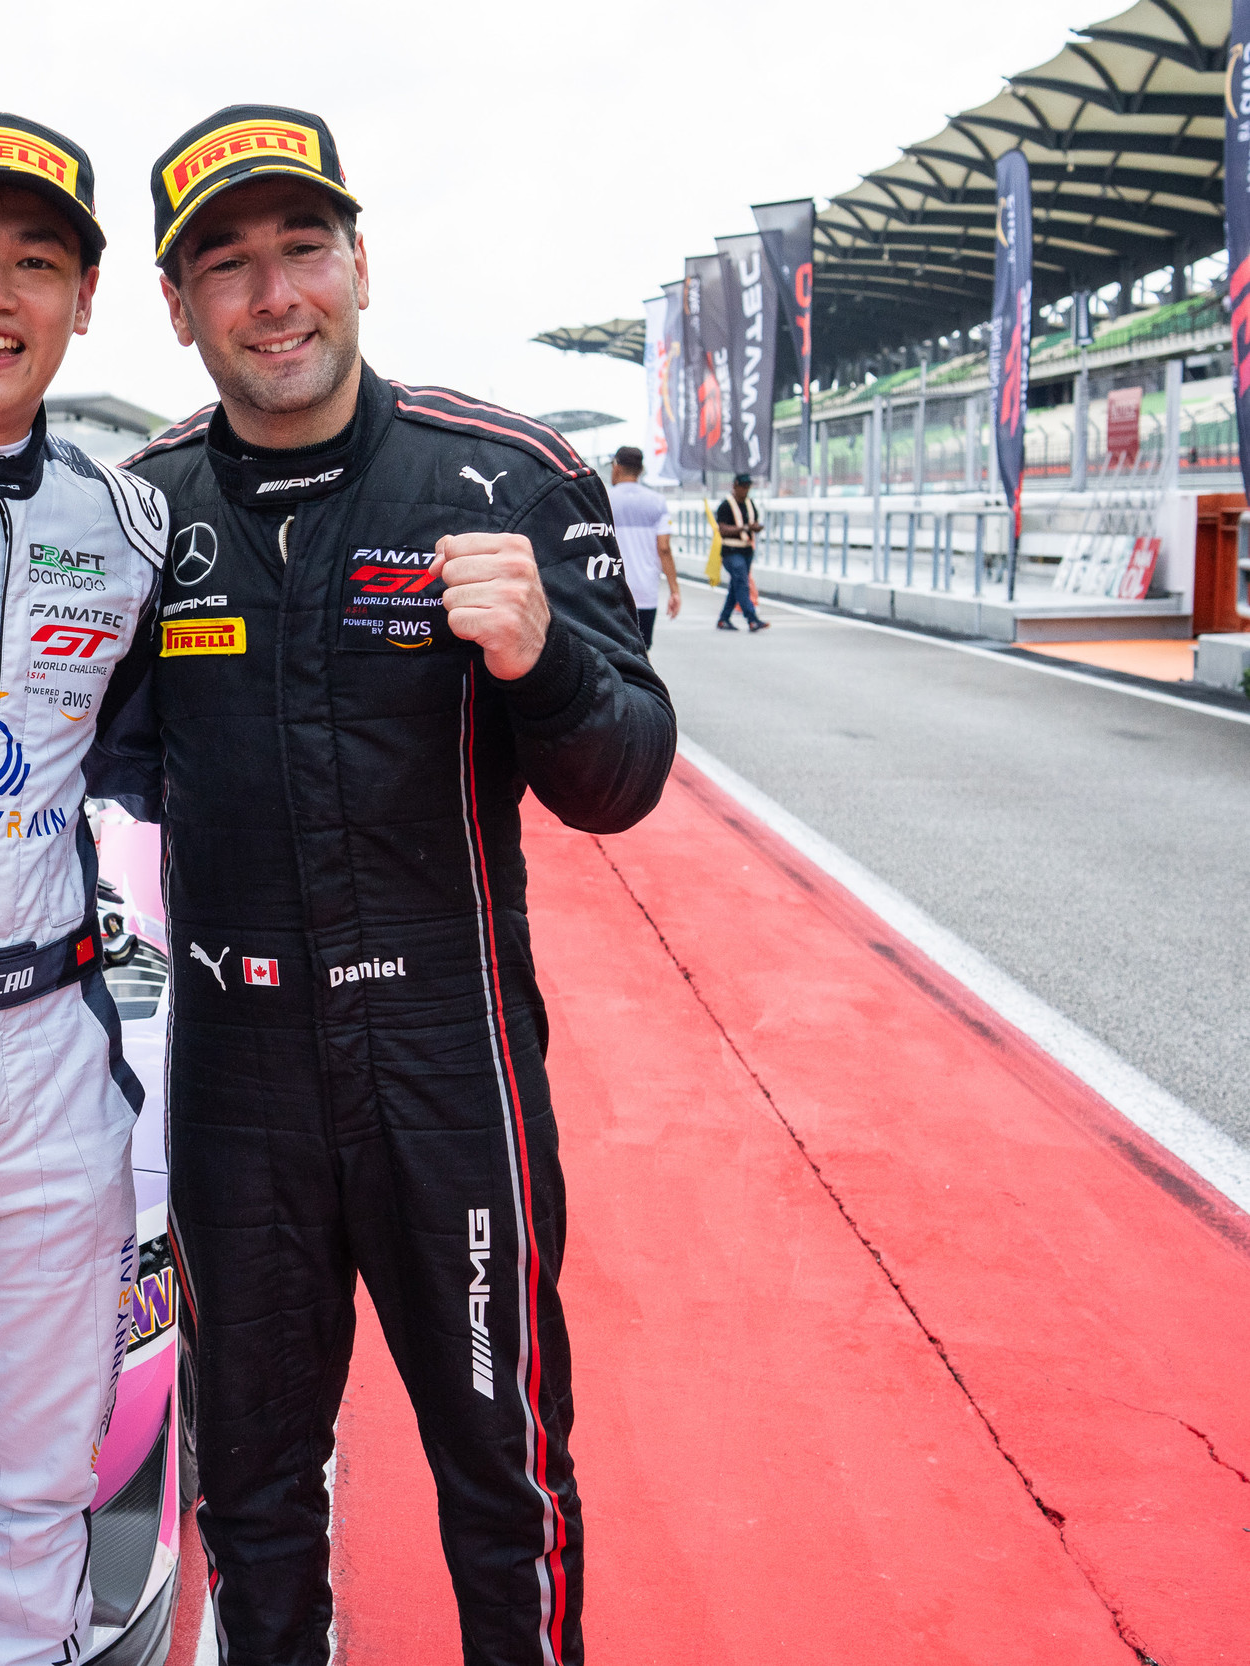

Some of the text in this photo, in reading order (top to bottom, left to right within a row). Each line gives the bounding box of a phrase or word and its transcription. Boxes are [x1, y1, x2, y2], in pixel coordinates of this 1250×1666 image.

[172, 126, 308, 194] PIRELLI
[285, 468, 345, 490] AMG
[30, 543, 106, 573] CRAFT
[29, 565, 107, 591] bamboo
[178, 595, 228, 612] AMG
[353, 597, 389, 605] WORLD
[30, 603, 124, 629] FANATEC
[343, 618, 384, 627] POWERED
[166, 624, 236, 650] PIRELLI
[372, 627, 383, 635] BY
[388, 620, 431, 636] aws
[31, 624, 119, 658] GT
[33, 660, 108, 677] WORLD CHALLENGE
[48, 696, 59, 705] BY
[62, 690, 93, 709] aws
[329, 957, 406, 988] Daniel
[468, 1208, 491, 1333] AMG
